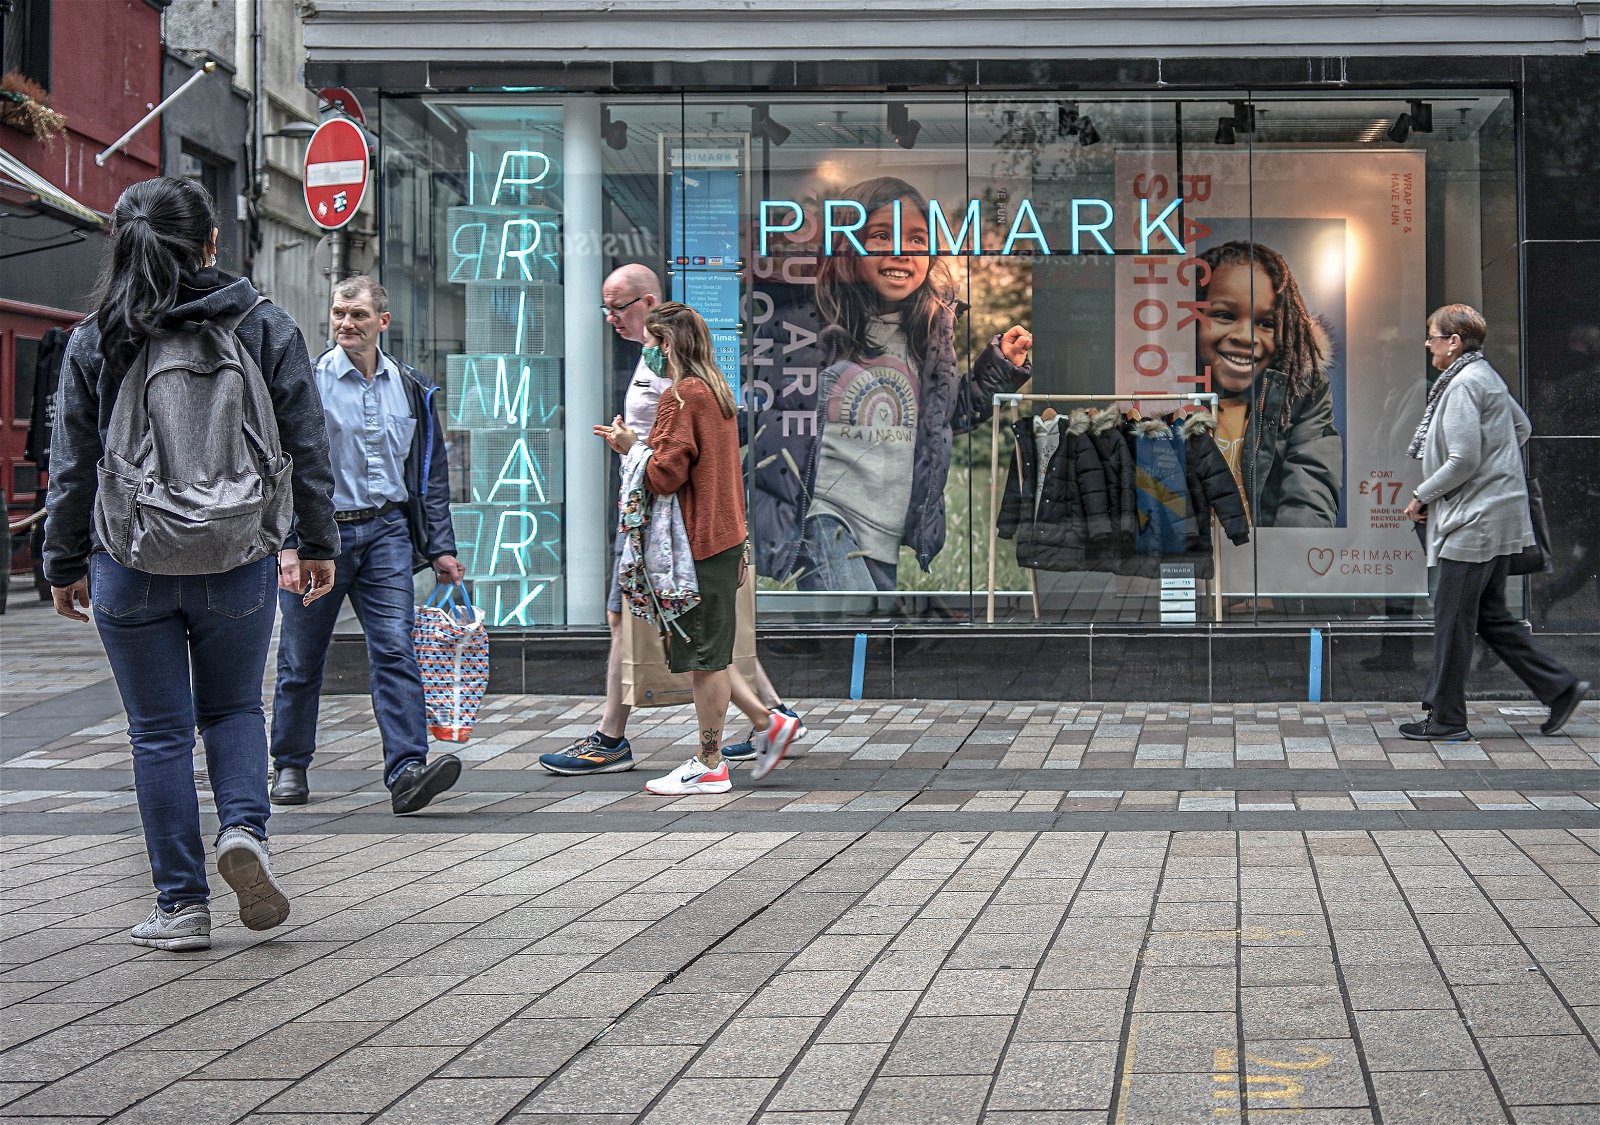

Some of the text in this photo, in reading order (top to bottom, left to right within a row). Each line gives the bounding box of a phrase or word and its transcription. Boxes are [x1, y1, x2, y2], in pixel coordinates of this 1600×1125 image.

[1391, 173, 1400, 226] HAVE FUN
[1403, 172, 1412, 205] WRAP
[758, 198, 1186, 256] PRIMARK
[996, 202, 1006, 223] FUN
[1403, 208, 1412, 223] UP
[1176, 174, 1212, 331] BACK
[712, 333, 737, 342] Times
[487, 149, 551, 627] PRIMARK
[782, 320, 818, 437] ARE
[1359, 480, 1404, 505] £17
[1340, 550, 1413, 560] PRIMARK
[1340, 564, 1394, 575] CARES
